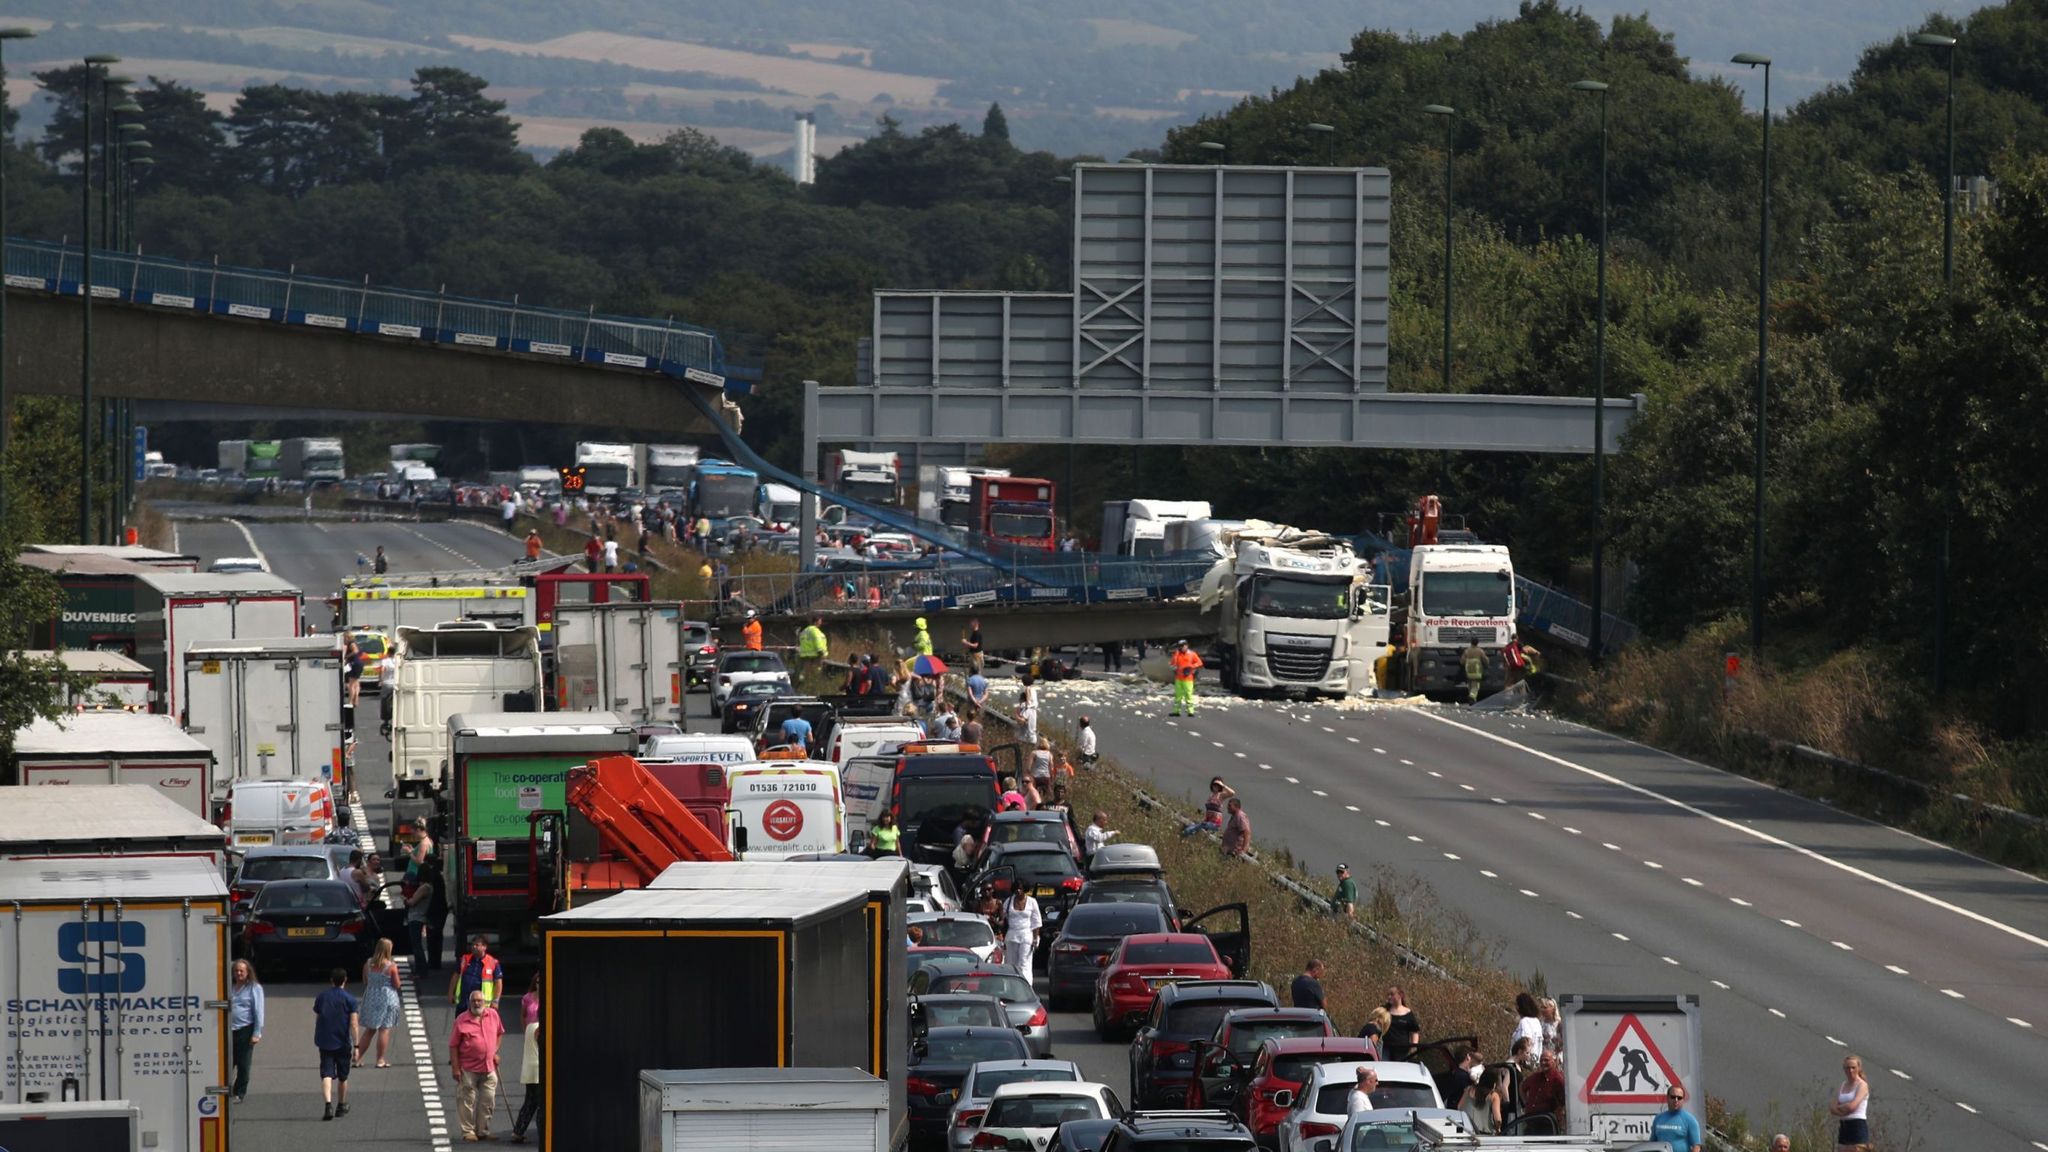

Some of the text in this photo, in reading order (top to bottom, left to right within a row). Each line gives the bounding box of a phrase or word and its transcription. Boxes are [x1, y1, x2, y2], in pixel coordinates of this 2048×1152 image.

[563, 474, 583, 489] 20
[1426, 618, 1509, 627] Auto Renovations
[710, 752, 744, 762] EVEN
[494, 772, 510, 783] The
[495, 786, 517, 798] food
[749, 783, 817, 792] 01536 721010
[6, 995, 200, 1013] SCHAVEMAKER
[8, 1014, 88, 1028] Logistics
[120, 1012, 203, 1024] Transport
[7, 1026, 203, 1038] schavemaker.com
[133, 1051, 180, 1059] BREDA
[133, 1068, 187, 1076] TRNAVA
[1608, 1120, 1619, 1134] 2
